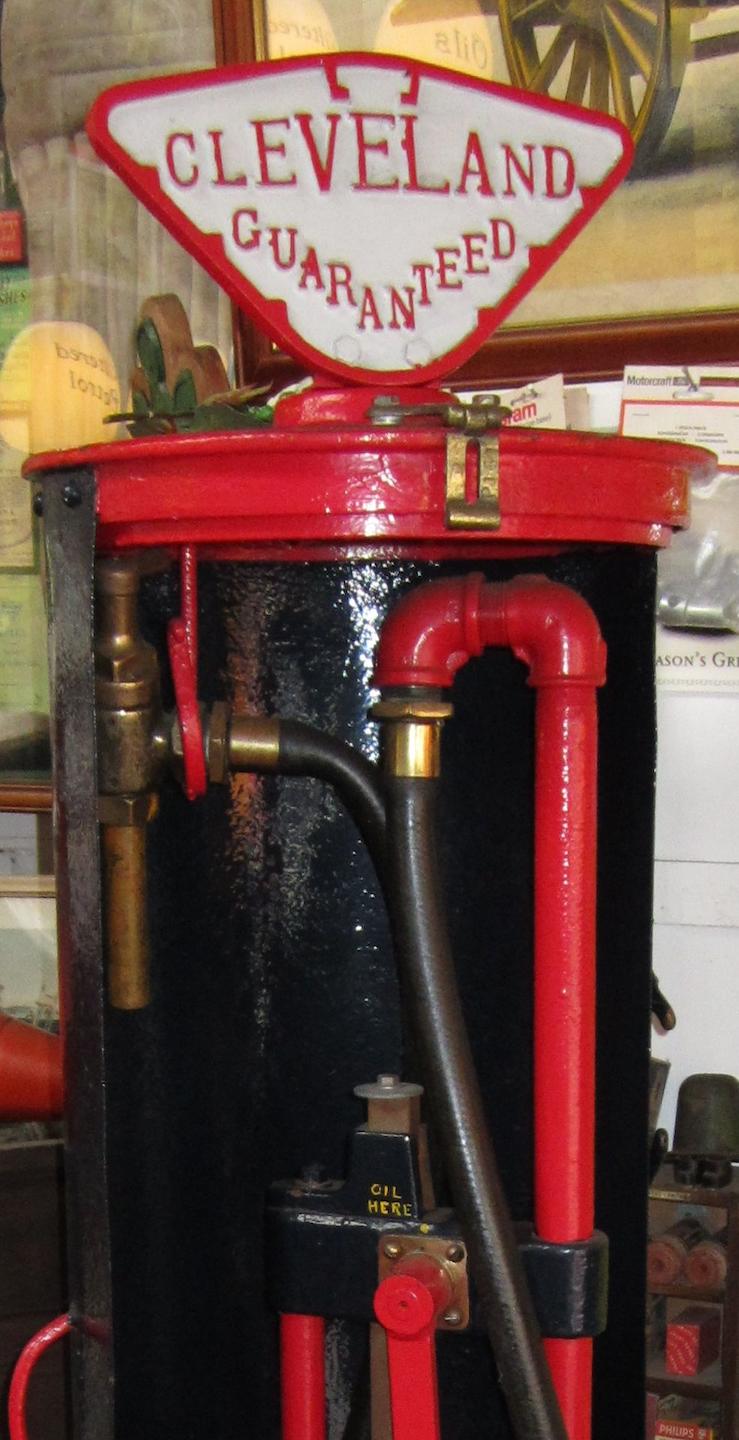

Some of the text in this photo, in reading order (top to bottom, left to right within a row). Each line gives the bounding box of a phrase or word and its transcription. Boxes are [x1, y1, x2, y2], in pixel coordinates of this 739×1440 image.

[165, 112, 576, 199] CLEVELAND
[231, 208, 516, 330] GUARANTEED
[627, 375, 672, 386] Motorcraft
[370, 1183, 402, 1199] OIL
[367, 1200, 412, 1217] HERE
[660, 1424, 694, 1438] PHILIPS
